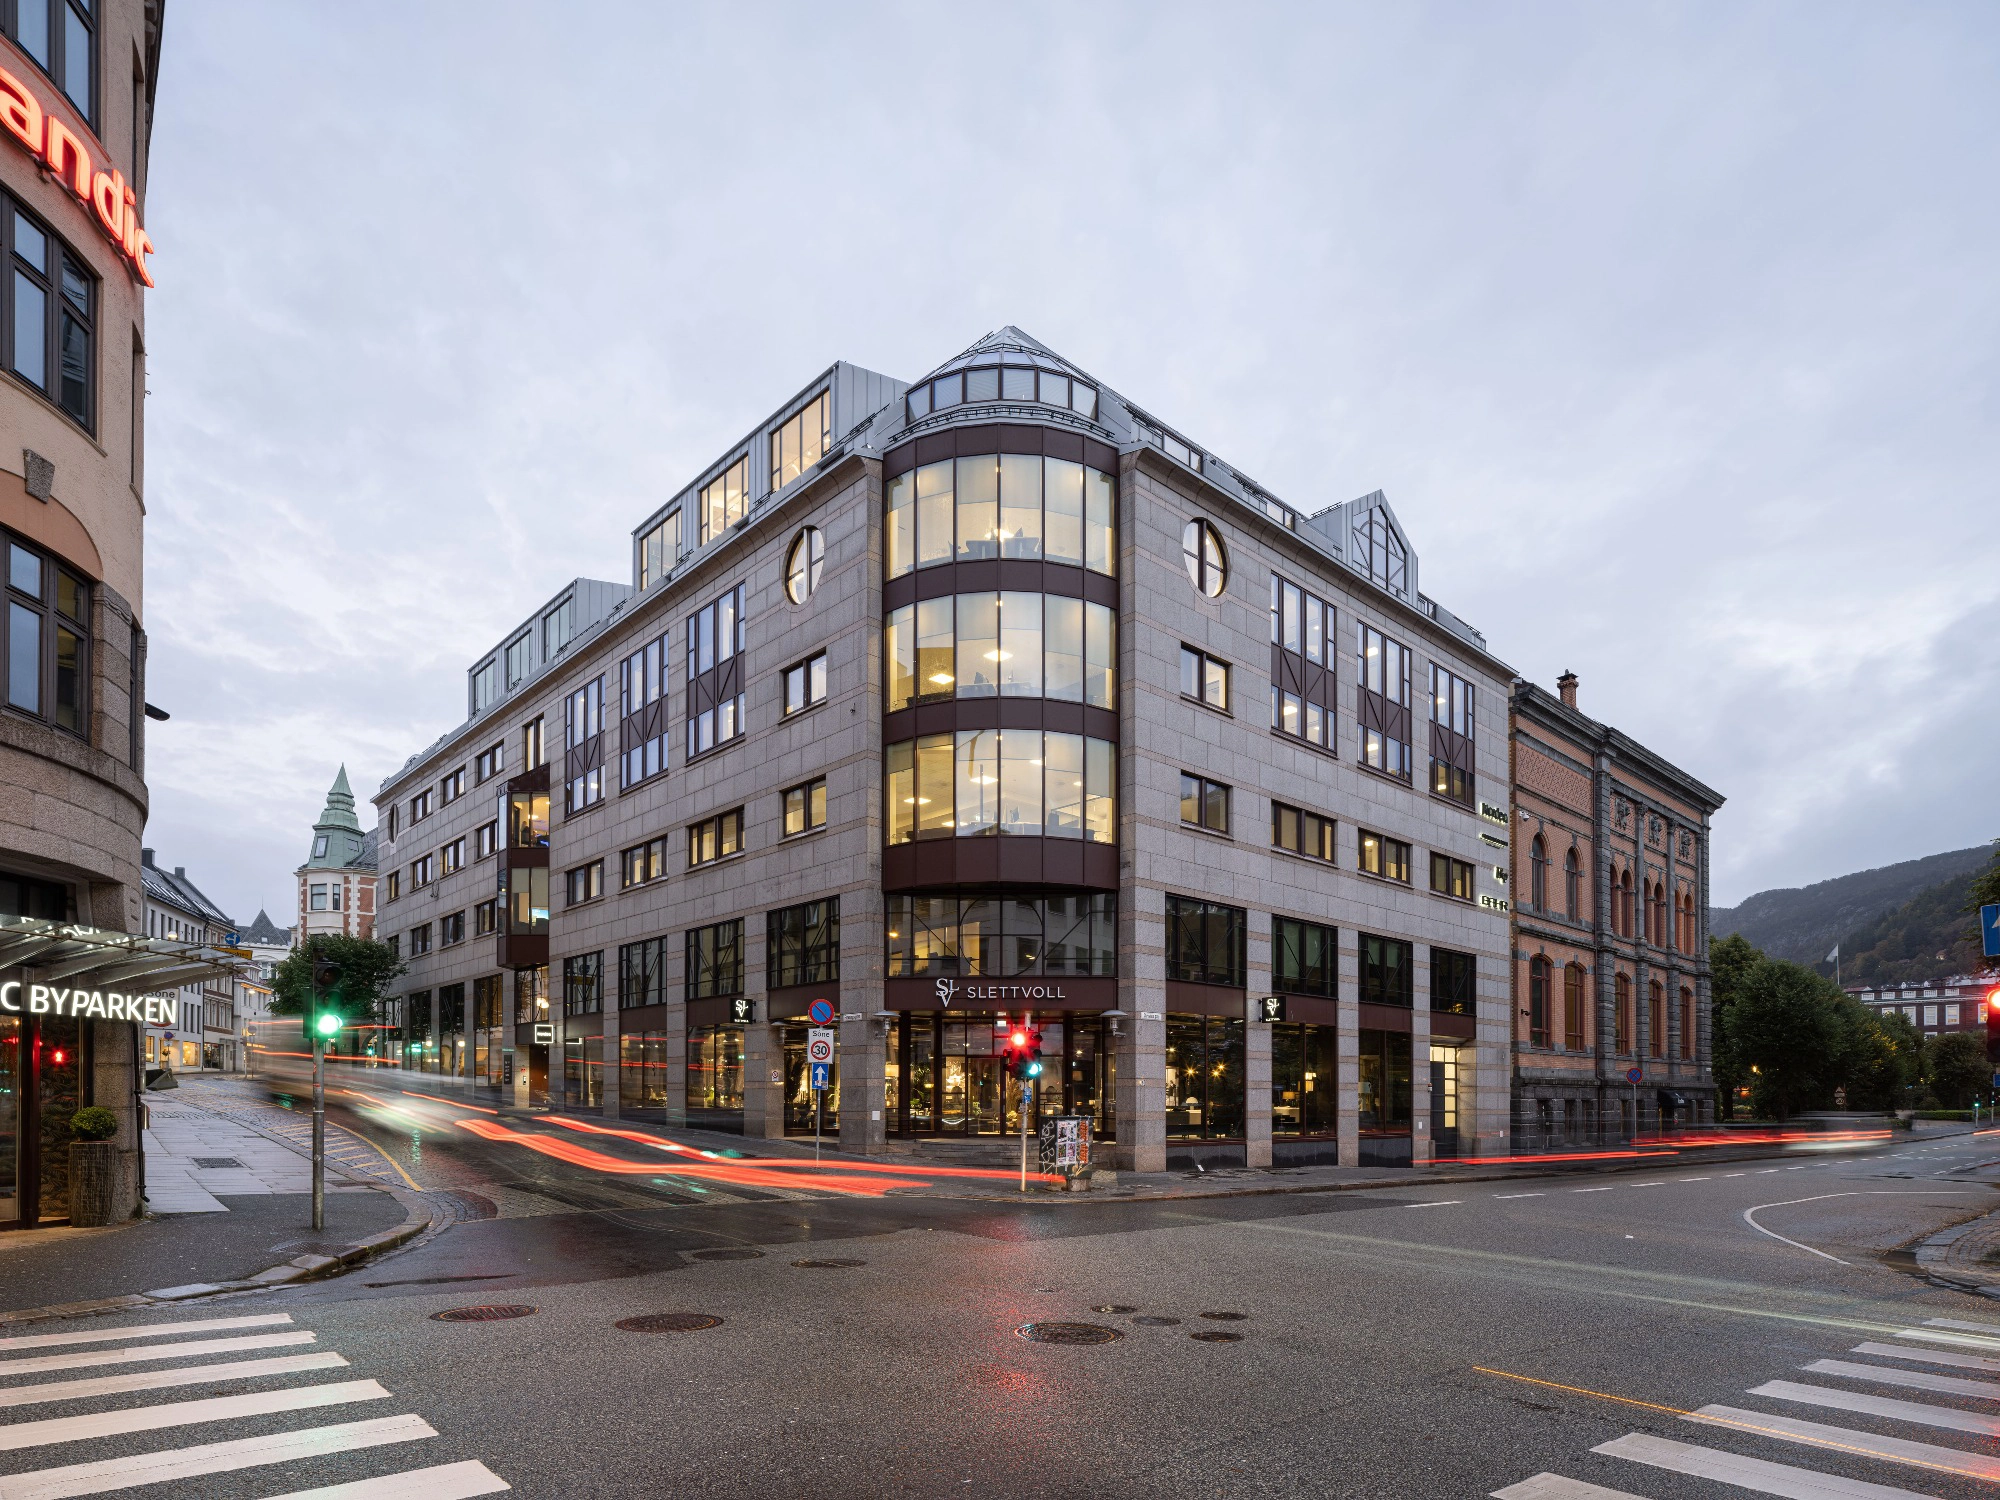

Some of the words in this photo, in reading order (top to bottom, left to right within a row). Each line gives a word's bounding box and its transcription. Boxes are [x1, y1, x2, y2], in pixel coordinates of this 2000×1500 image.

[0, 66, 155, 289] andic
[967, 986, 1066, 999] SLETTVOLL
[30, 984, 177, 1024] BYPARKEN
[812, 1030, 830, 1038] Sone
[814, 1045, 828, 1056] 30
